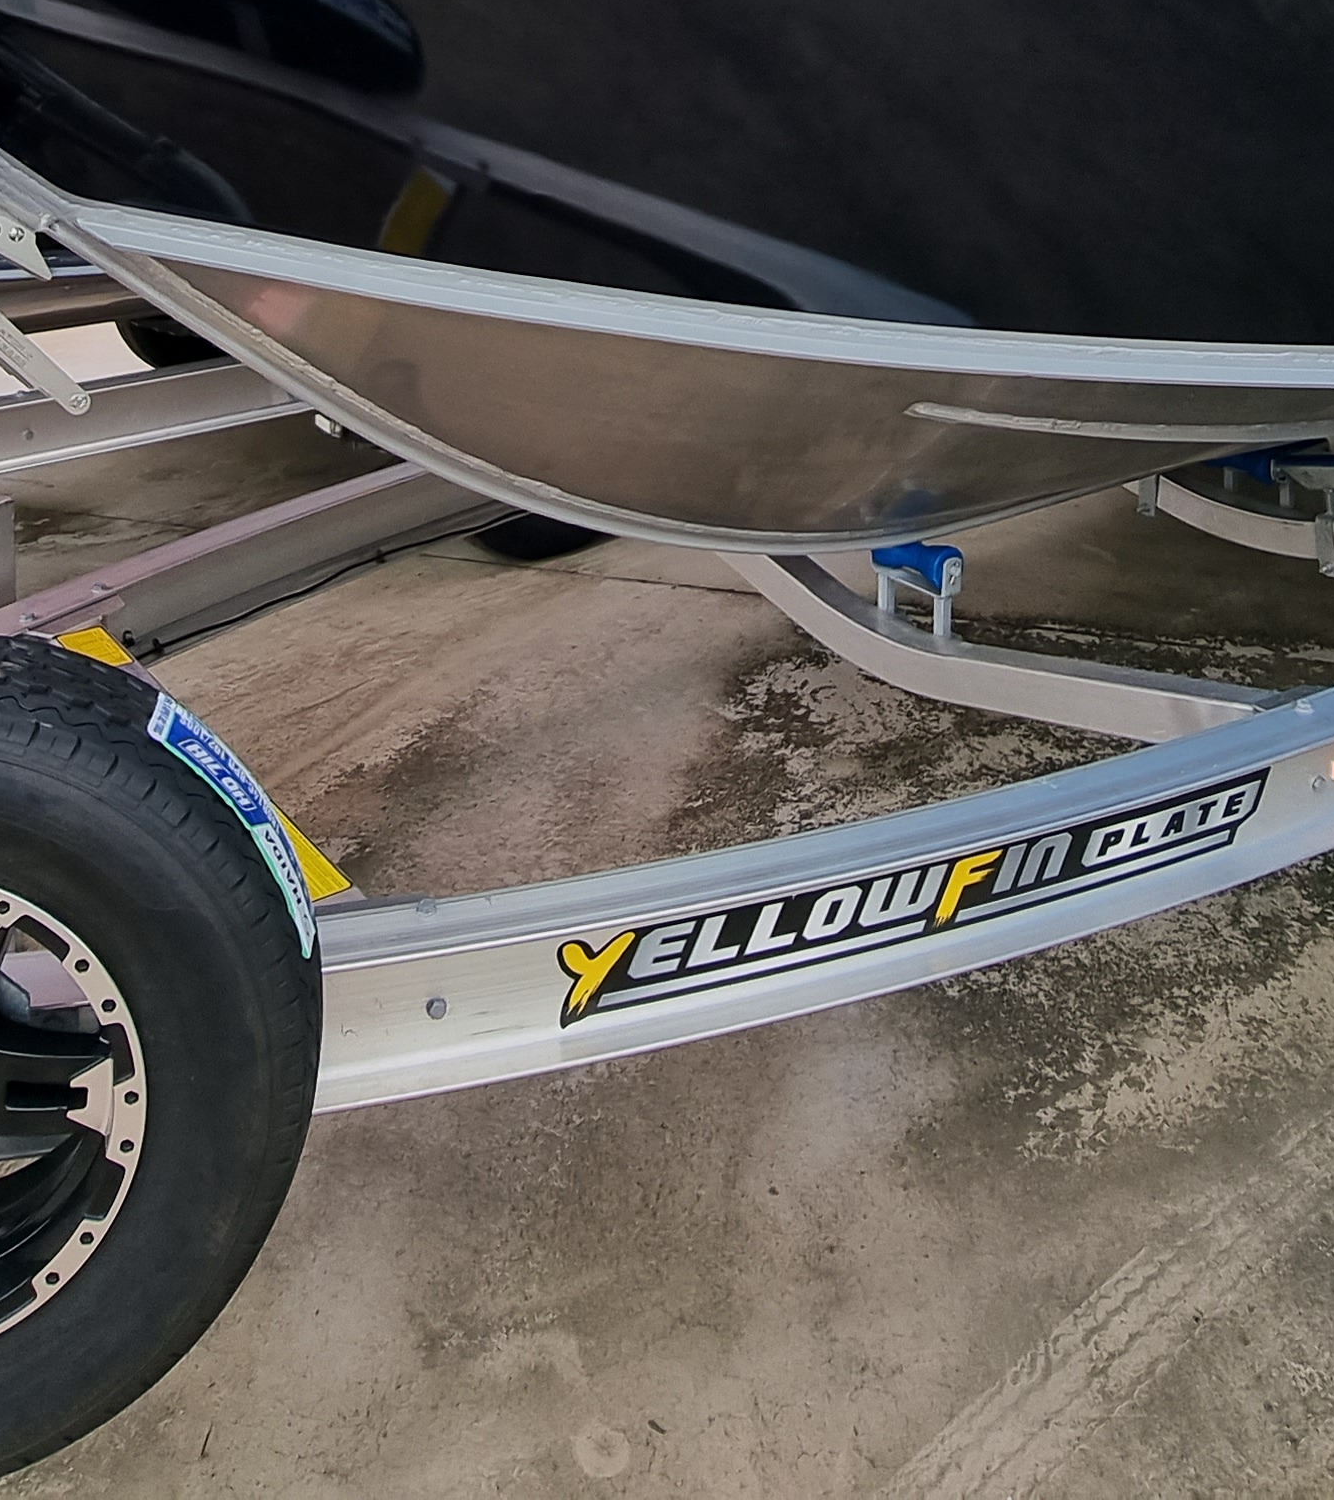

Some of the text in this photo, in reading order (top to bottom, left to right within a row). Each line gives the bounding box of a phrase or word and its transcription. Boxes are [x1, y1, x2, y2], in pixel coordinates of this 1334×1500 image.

[263, 827, 303, 906] HAIDA
[564, 789, 1249, 1017] YELLOWFIN PLATE
